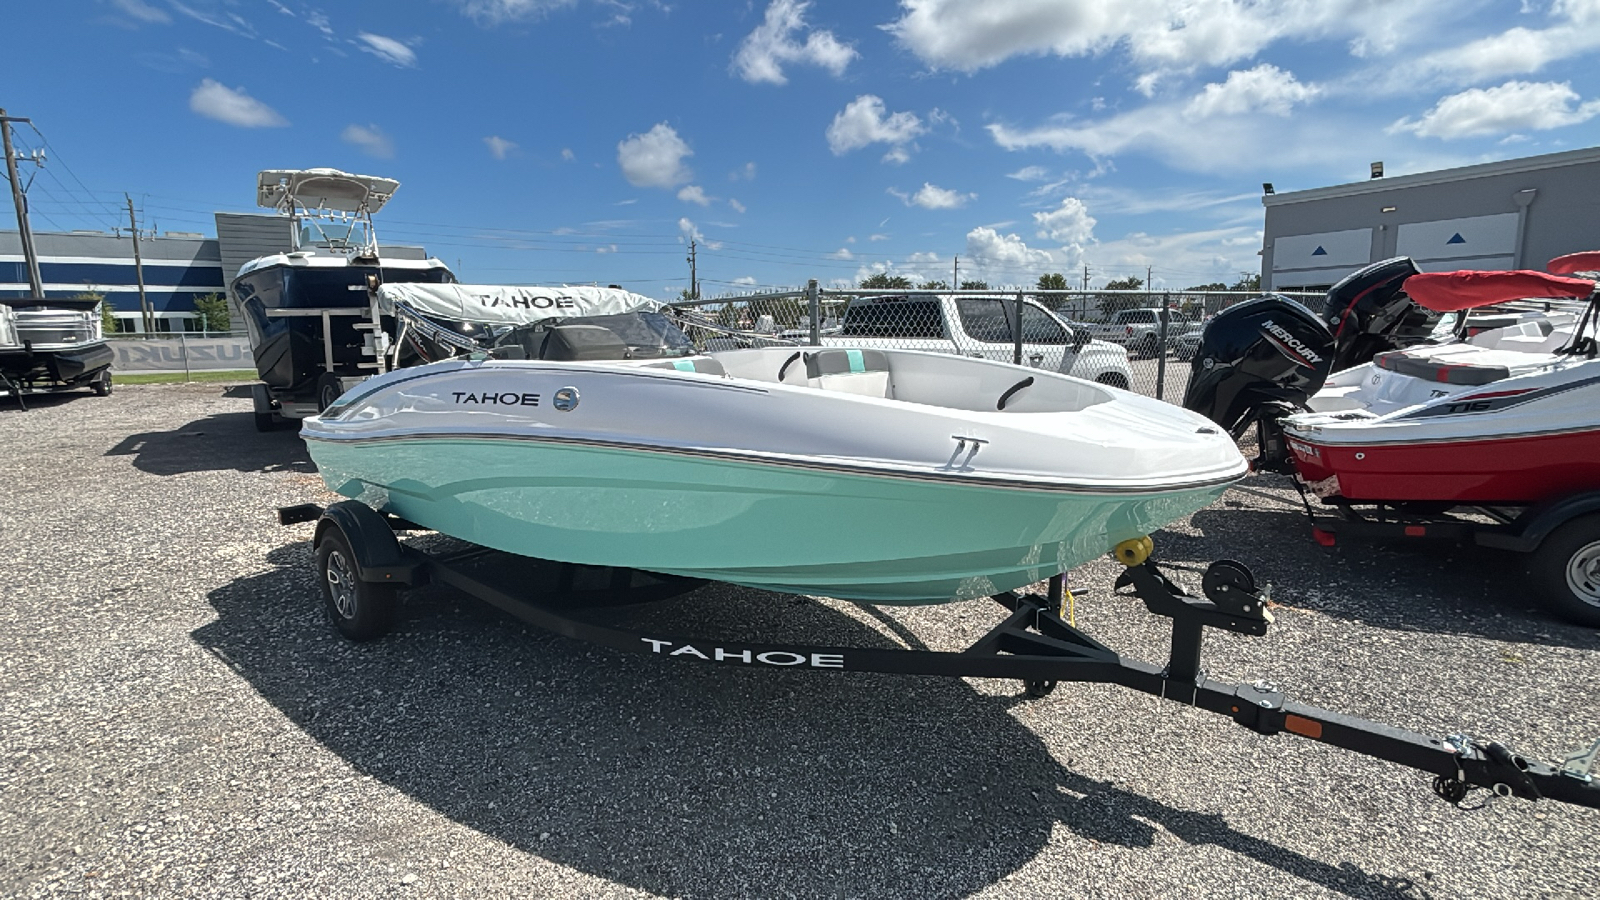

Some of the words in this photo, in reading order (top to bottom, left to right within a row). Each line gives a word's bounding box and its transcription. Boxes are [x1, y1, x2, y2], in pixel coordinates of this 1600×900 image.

[479, 294, 574, 309] TAHOE
[1261, 319, 1323, 363] MERCURY
[452, 391, 541, 407] TAHOE
[1446, 400, 1492, 413] T16
[640, 637, 844, 668] TAHOE
